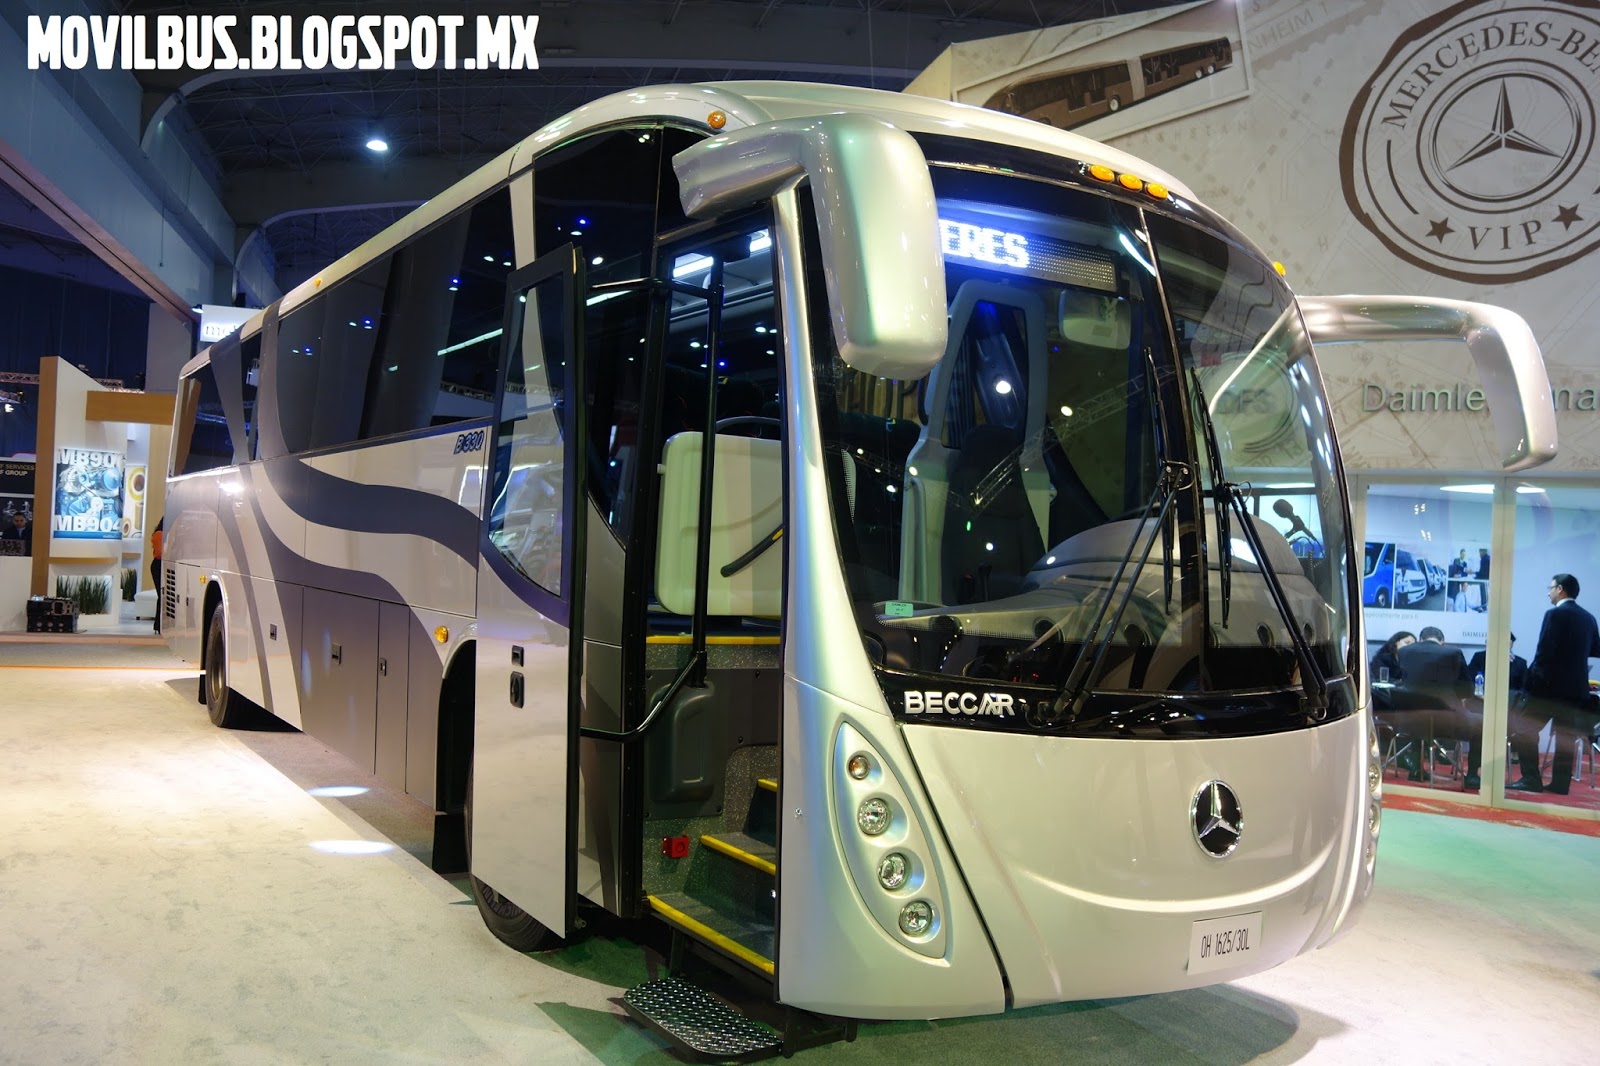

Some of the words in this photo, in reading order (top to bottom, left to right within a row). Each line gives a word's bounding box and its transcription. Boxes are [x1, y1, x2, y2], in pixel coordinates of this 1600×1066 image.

[1468, 219, 1542, 250] VIP
[1363, 383, 1487, 412] Daimle
[1365, 612, 1400, 620] specialmente
[904, 691, 1015, 716] BECCAR
